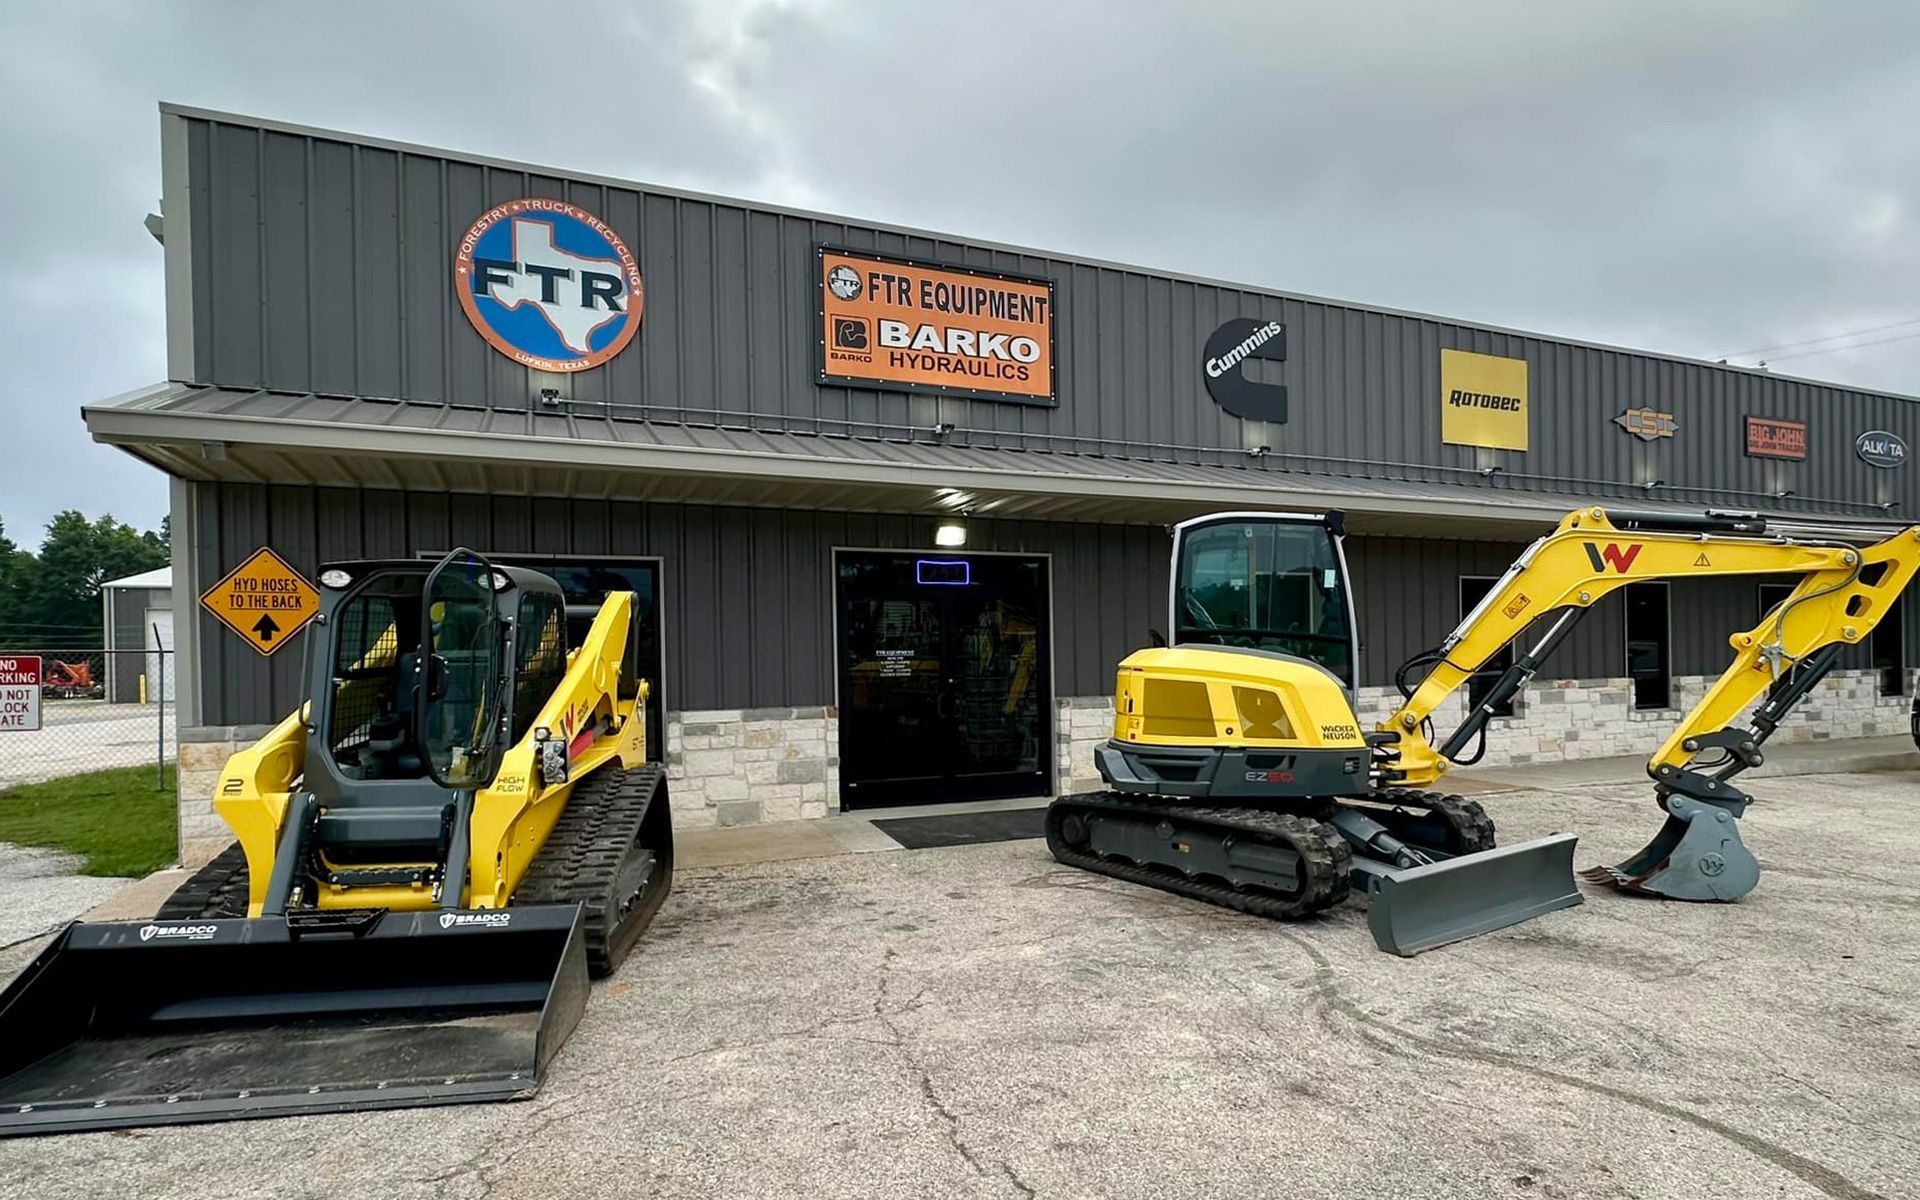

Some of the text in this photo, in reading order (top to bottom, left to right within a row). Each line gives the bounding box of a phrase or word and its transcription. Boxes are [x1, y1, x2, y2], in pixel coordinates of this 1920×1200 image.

[459, 199, 641, 287] FORESTRY TRUCK RECYCLING
[474, 257, 624, 312] FTR
[831, 277, 860, 288] FTR
[868, 271, 1048, 325] FTR EQUIPMENT
[878, 318, 1041, 364] BARKO
[1205, 320, 1283, 379] Cummins
[559, 358, 591, 370] TEXAS
[830, 352, 873, 364] BARKO
[889, 351, 1030, 381] HYDRAULICS
[1626, 409, 1674, 438] CSI
[1750, 424, 1805, 445] BIG JOHN
[234, 577, 298, 592] HYD HOSES
[229, 594, 302, 609] TO THE BACK
[0, 659, 17, 671] NO
[0, 672, 36, 684] RKING
[7, 689, 32, 701] NOT
[0, 714, 25, 726] ATE
[1321, 724, 1354, 732] WACKER
[1323, 732, 1357, 740] NEUSON
[223, 778, 244, 793] 2
[497, 776, 526, 784] HIGH
[496, 784, 524, 792] FLOW
[456, 913, 511, 923] BRADCO
[157, 925, 218, 935] BRADCO
